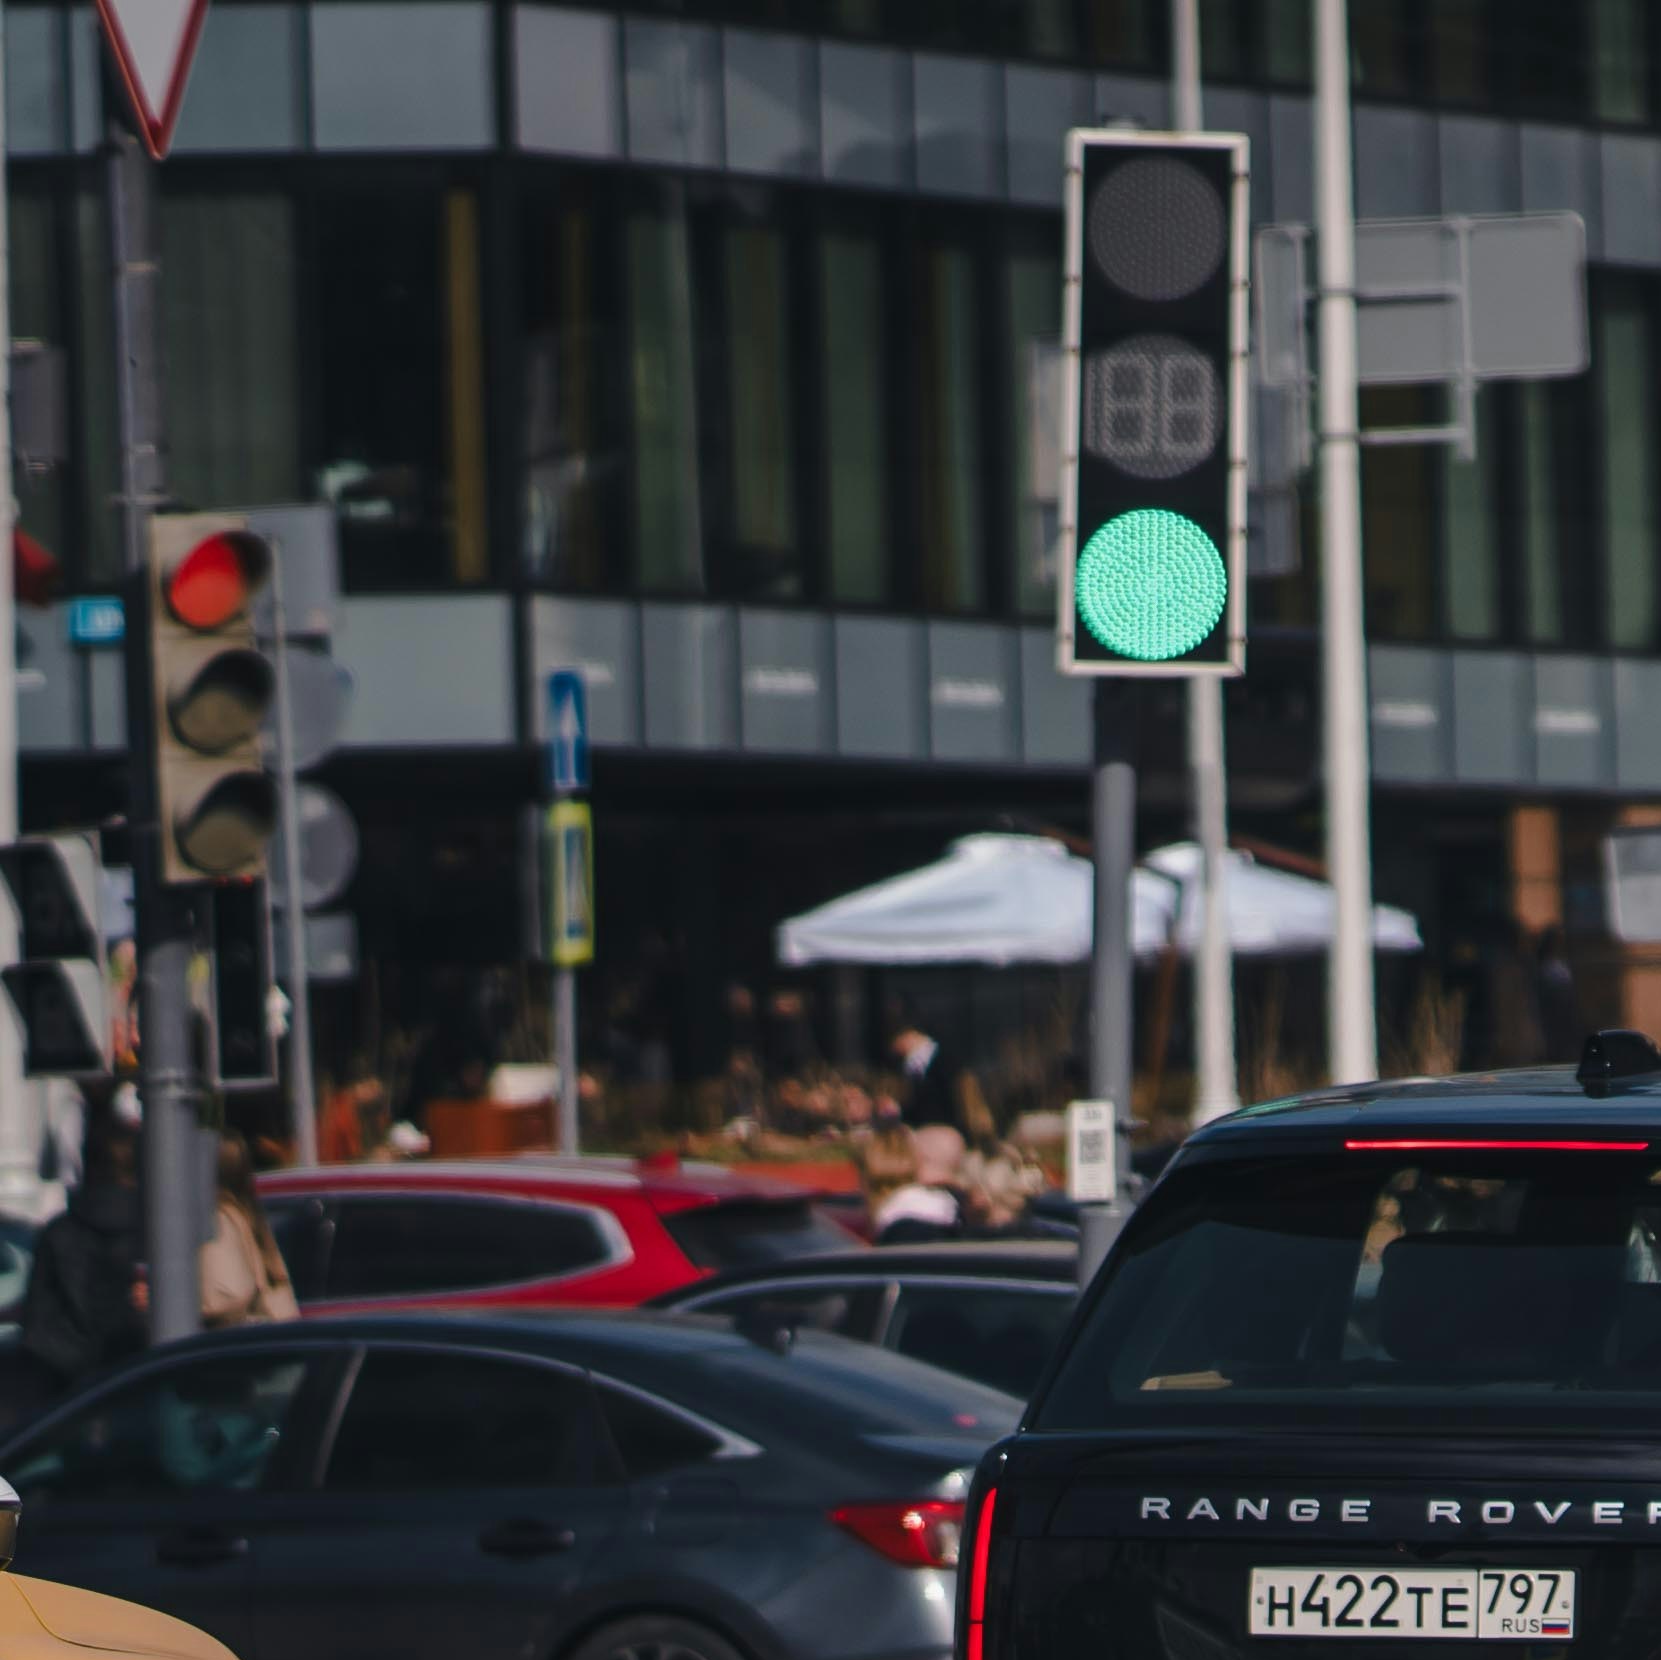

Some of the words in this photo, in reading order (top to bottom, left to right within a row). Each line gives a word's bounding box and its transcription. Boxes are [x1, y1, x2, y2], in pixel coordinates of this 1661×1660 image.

[1141, 1497, 1371, 1522] RANGE
[1483, 1573, 1561, 1615] 797
[1502, 1619, 1540, 1634] RUS
